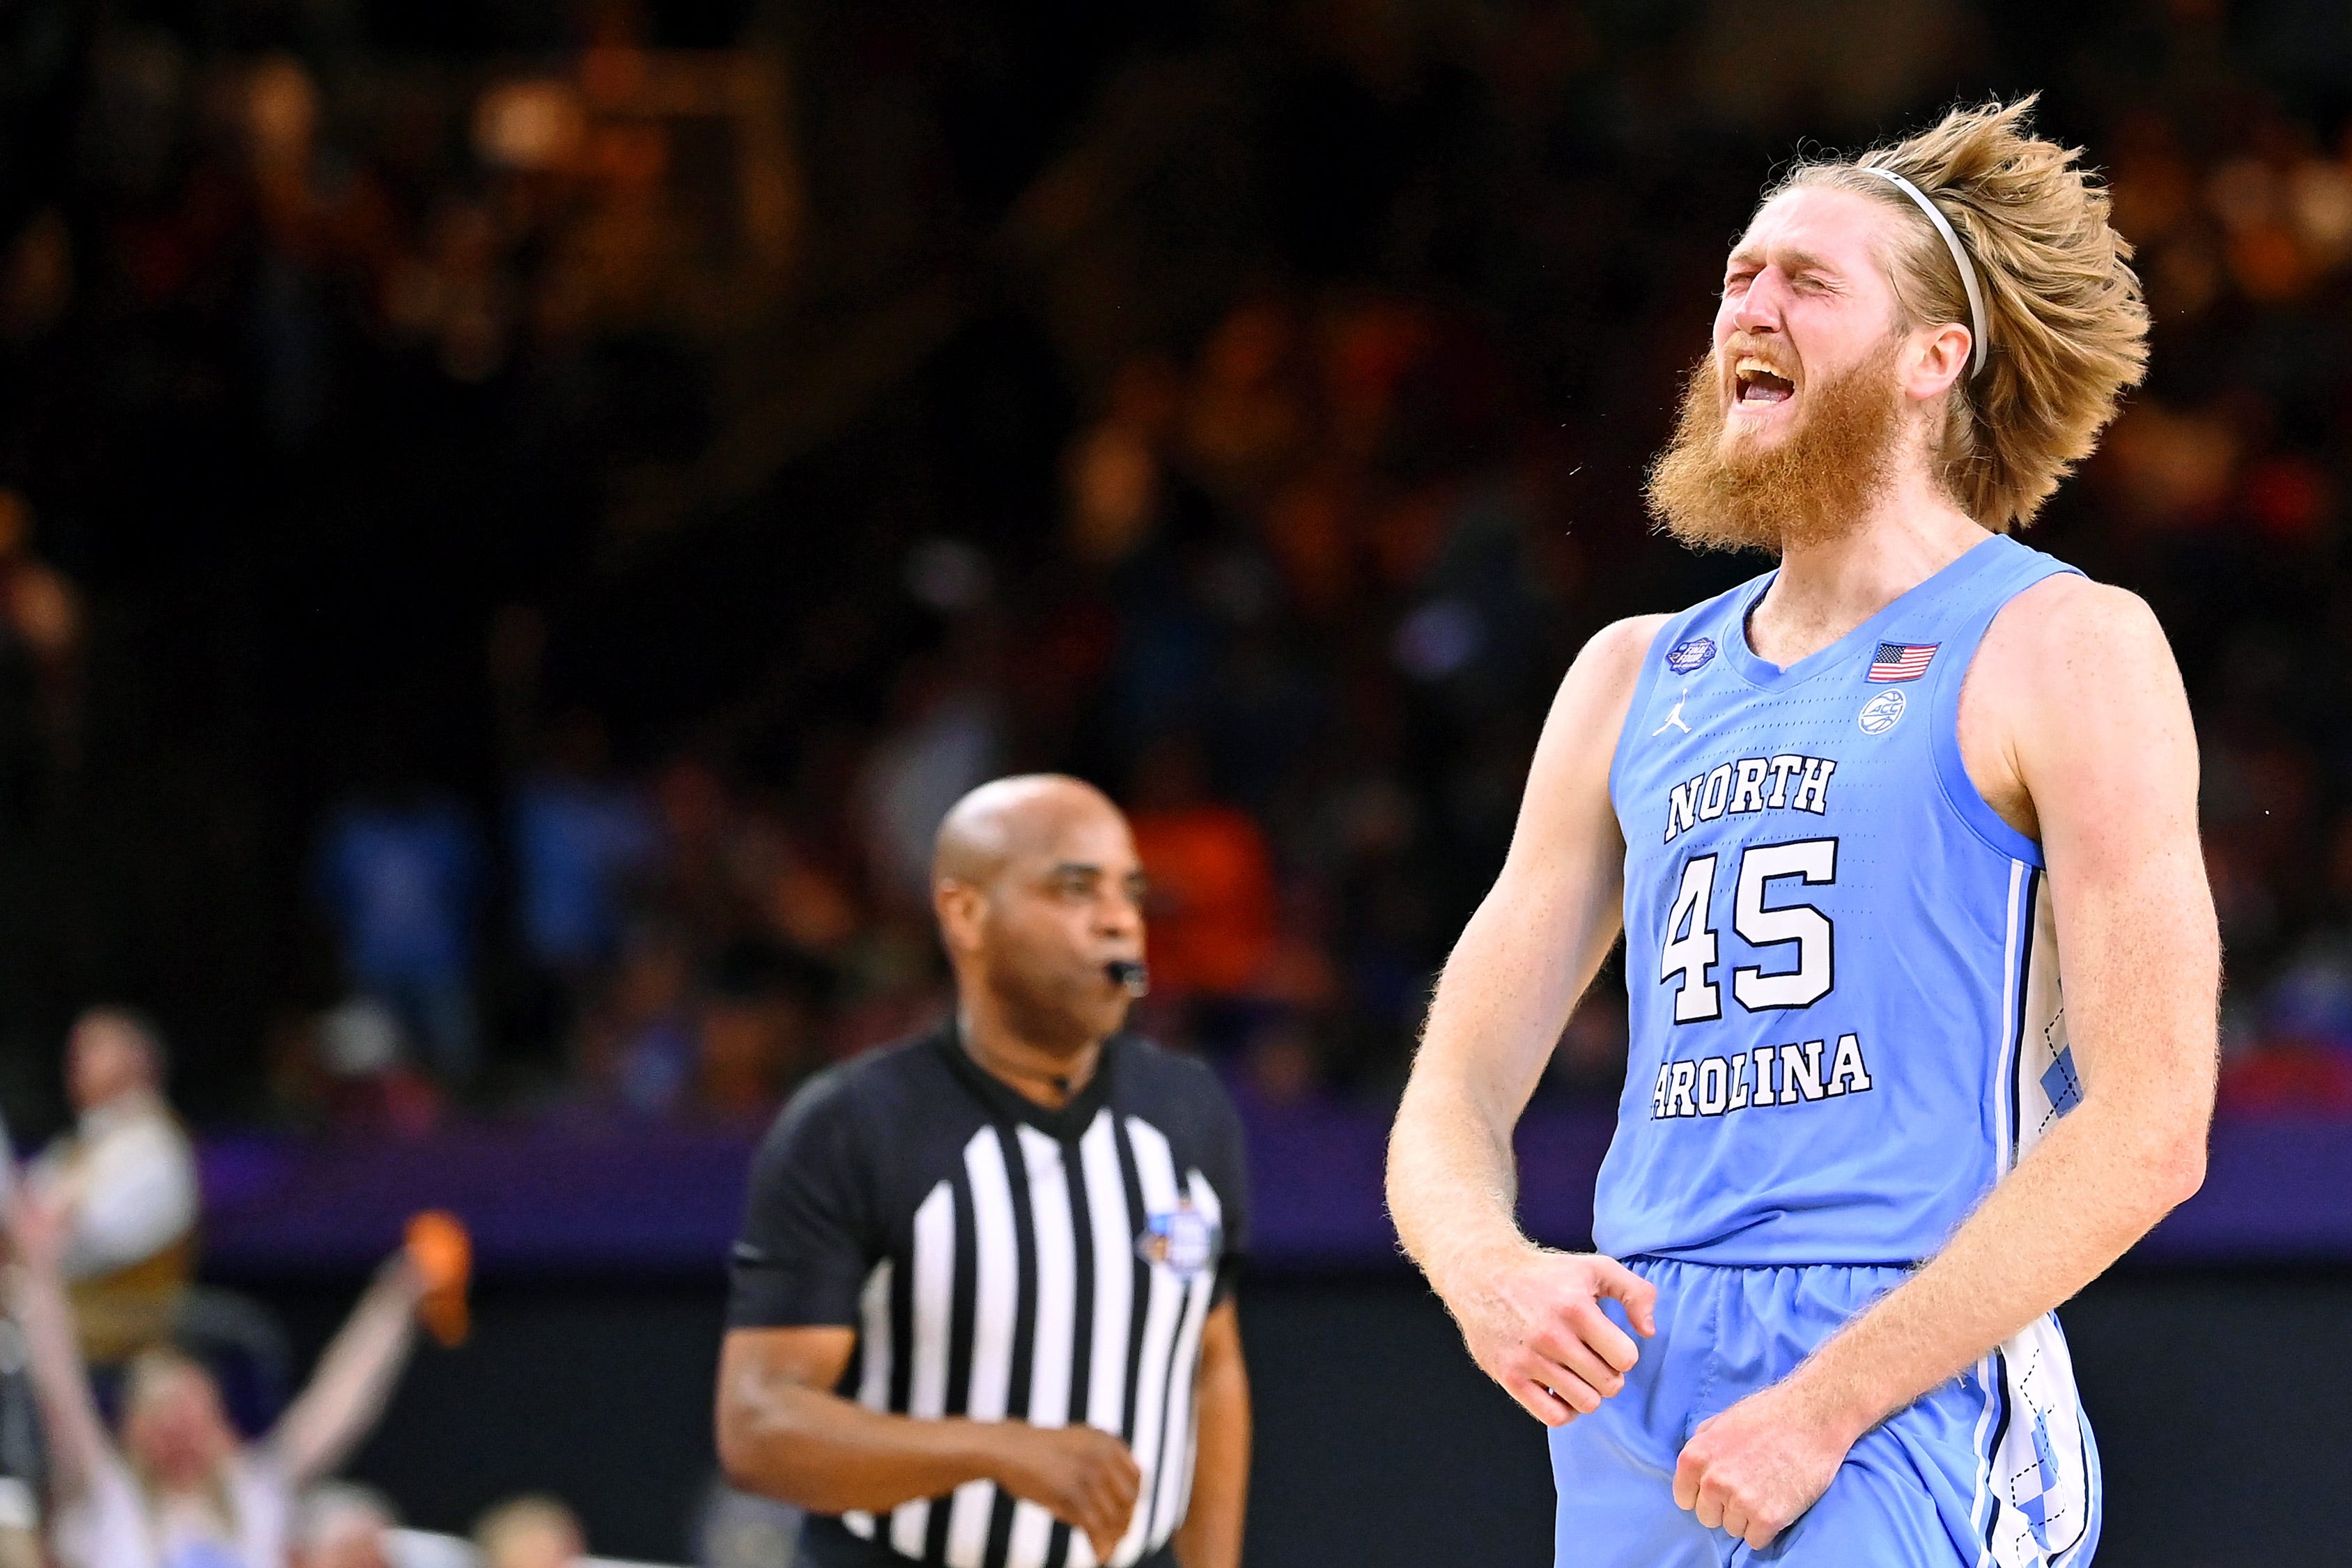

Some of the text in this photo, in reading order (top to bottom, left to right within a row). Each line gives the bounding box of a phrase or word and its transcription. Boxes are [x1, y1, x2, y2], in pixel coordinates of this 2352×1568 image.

[1682, 645, 1709, 655] FINAL
[1868, 703, 1901, 714] ACC
[1664, 754, 1837, 844] NORTH
[1660, 837, 1839, 1025] 45
[1650, 1033, 1872, 1121] AROLINA
